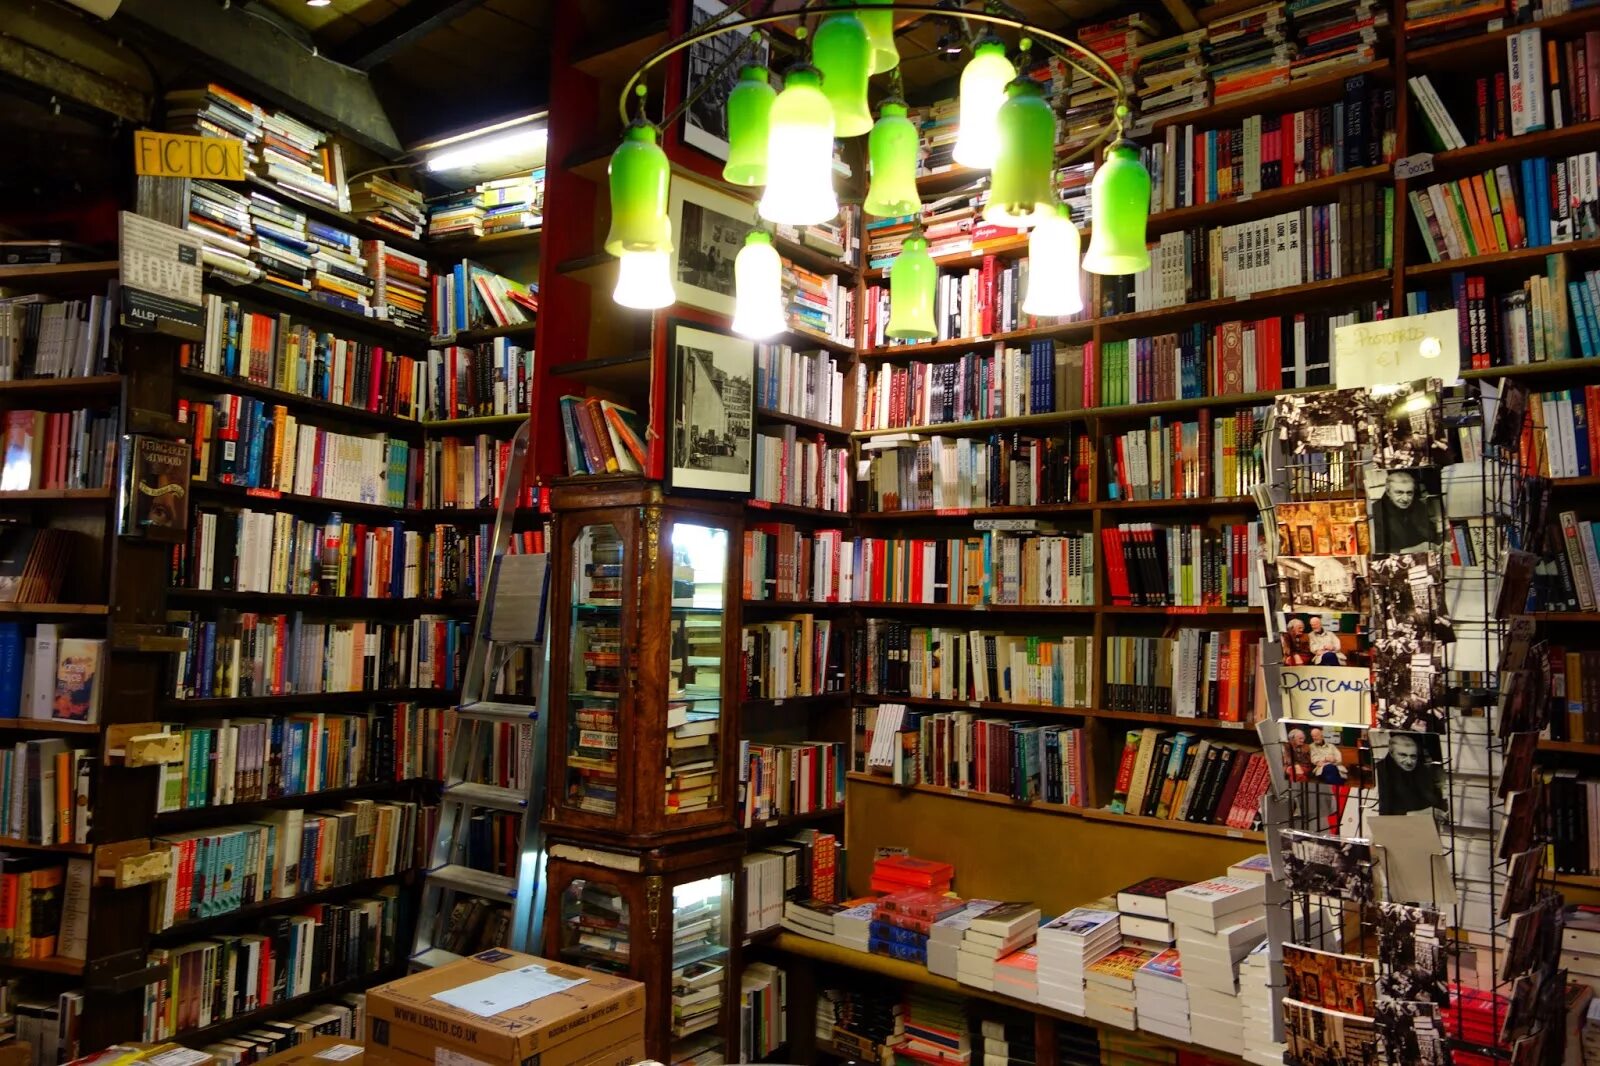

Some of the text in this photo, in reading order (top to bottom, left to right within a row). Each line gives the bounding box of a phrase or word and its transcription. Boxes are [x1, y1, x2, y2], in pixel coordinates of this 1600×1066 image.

[140, 136, 241, 177] FICTION
[131, 308, 158, 321] ALLE
[1280, 672, 1370, 694] POSTCARDS
